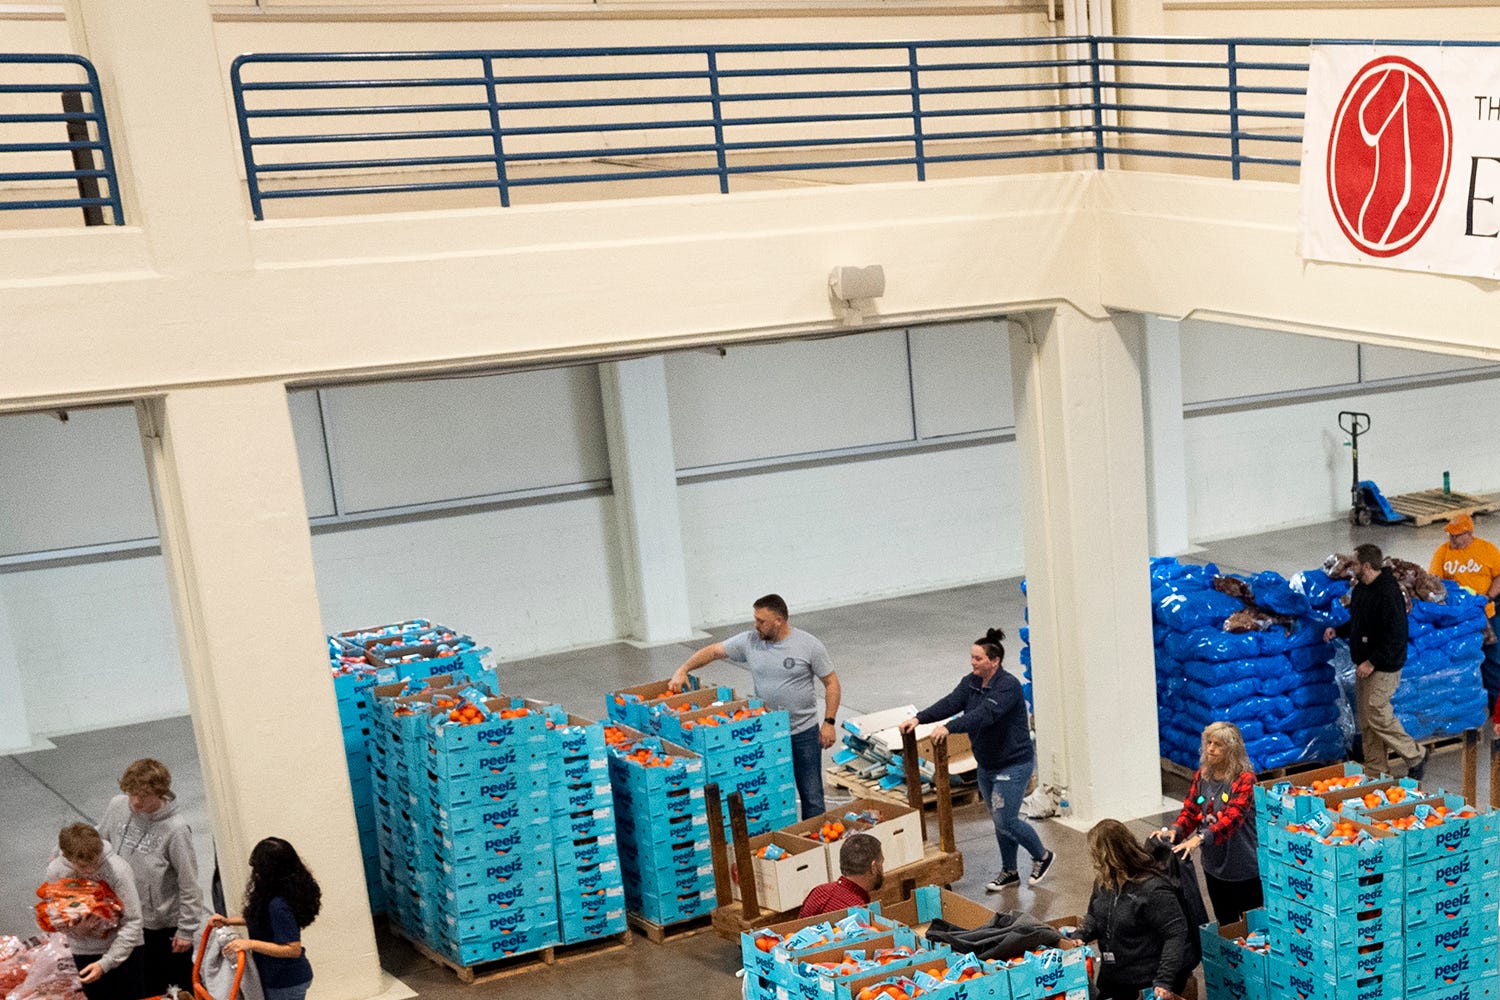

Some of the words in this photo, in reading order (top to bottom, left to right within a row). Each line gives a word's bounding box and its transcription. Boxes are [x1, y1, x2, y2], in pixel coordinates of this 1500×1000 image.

[1444, 559, 1483, 575] Vols
[430, 660, 464, 675] peelz
[477, 725, 514, 741] peelz
[732, 722, 762, 738] peelz
[562, 738, 586, 750] peelz
[480, 753, 516, 768] peelz
[734, 749, 764, 765] peelz
[565, 766, 589, 777] peelz
[481, 780, 517, 796] peelz
[736, 775, 767, 791] peelz
[569, 792, 594, 804] peelz
[483, 807, 519, 823] peelz
[745, 802, 770, 814] eelz
[572, 820, 596, 831] peelz
[485, 835, 521, 850] peelz
[1437, 828, 1470, 846] peelz
[575, 846, 599, 859] peelz
[1288, 842, 1312, 858] peelz
[487, 861, 522, 877] peelz
[1436, 862, 1470, 880] peelz
[578, 874, 602, 886] peelz
[1288, 877, 1313, 892] peelz
[488, 888, 524, 903] peelz
[581, 898, 606, 910] peelz
[1436, 896, 1470, 913] peelz
[490, 913, 525, 929] peelz
[1288, 910, 1313, 927] peelz
[584, 922, 608, 934] peelz
[492, 934, 527, 951] peelz
[1435, 928, 1469, 946] peelz
[1290, 943, 1313, 961] peelz
[1435, 960, 1468, 978] peelz
[1035, 968, 1064, 987] peelz
[1290, 976, 1314, 993] peelz
